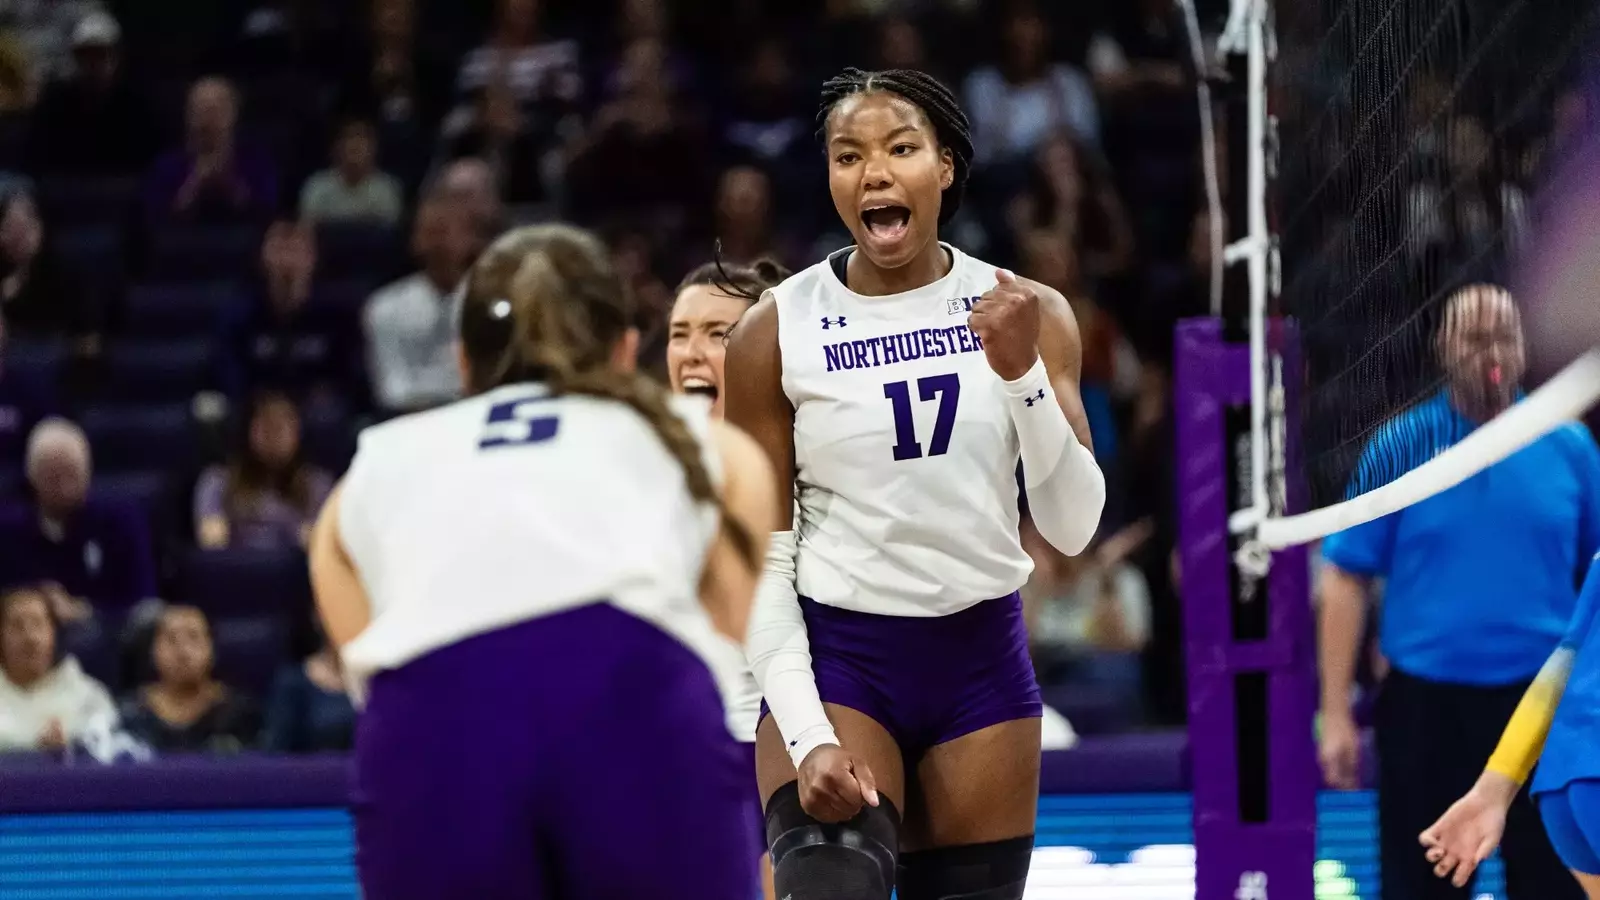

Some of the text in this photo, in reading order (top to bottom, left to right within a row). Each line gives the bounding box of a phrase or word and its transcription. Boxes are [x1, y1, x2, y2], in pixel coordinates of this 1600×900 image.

[946, 296, 981, 315] B1
[823, 325, 983, 372] NORTHWESTER
[478, 397, 560, 449] 5
[884, 374, 960, 461] 17
